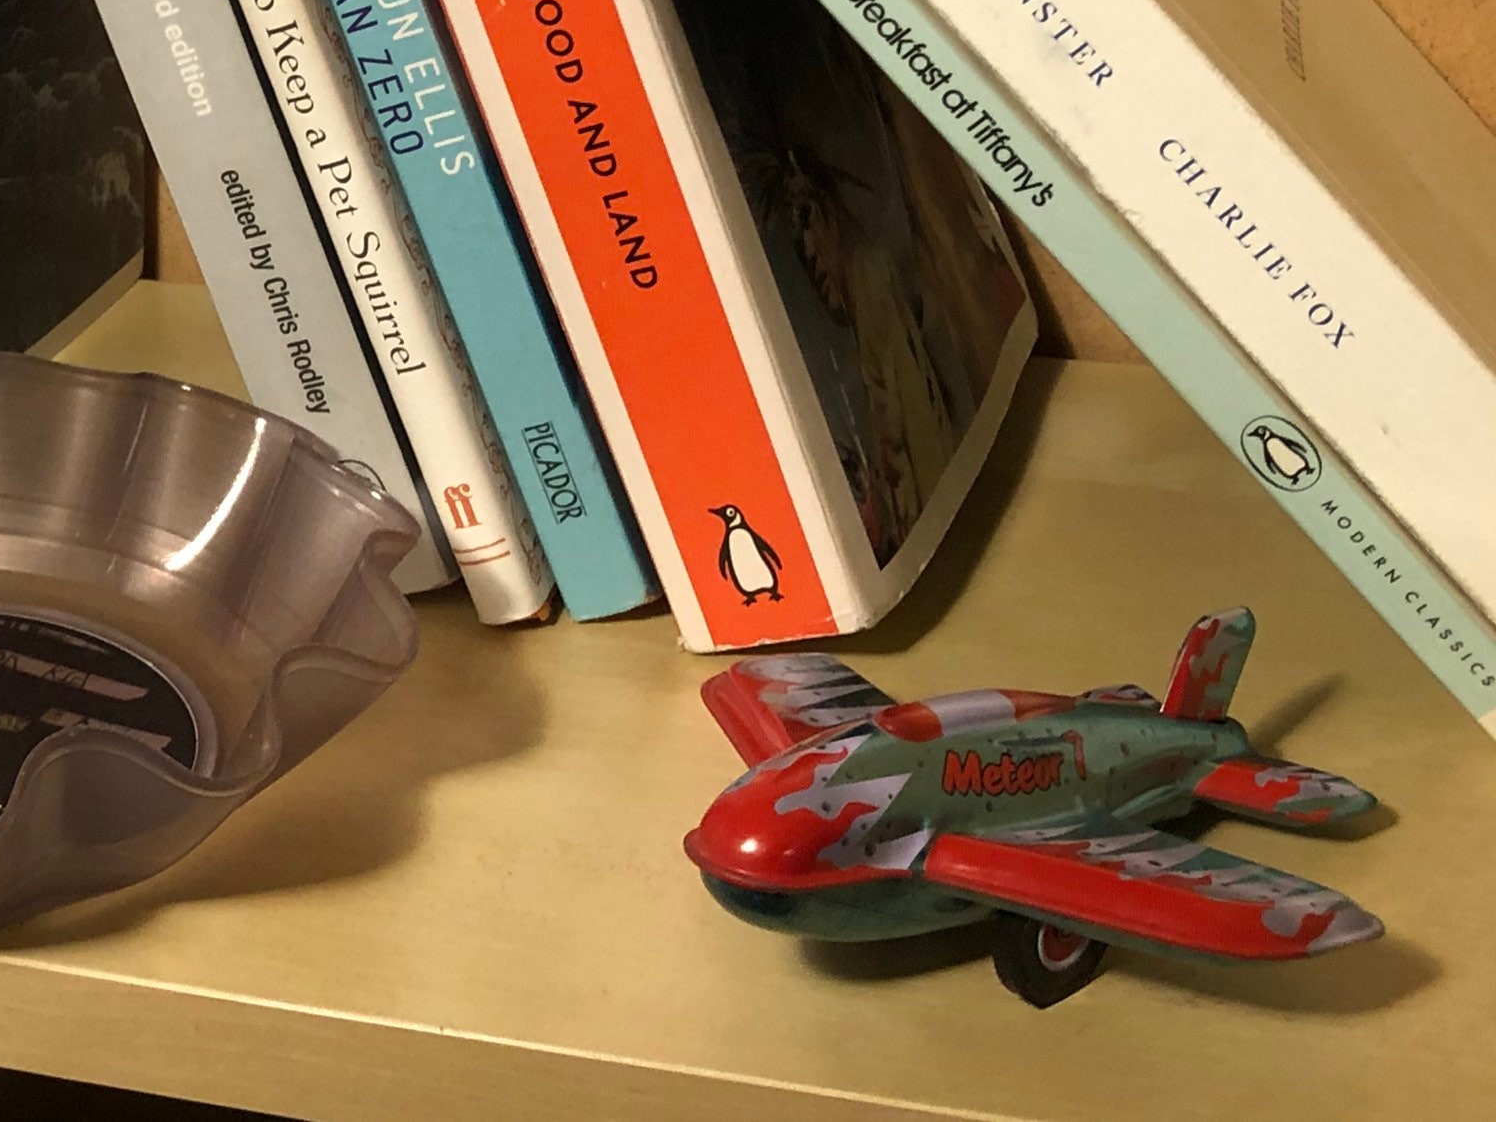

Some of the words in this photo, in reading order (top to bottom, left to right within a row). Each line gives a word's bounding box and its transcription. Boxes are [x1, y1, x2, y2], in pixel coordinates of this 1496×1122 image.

[164, 24, 213, 117] edition
[355, 48, 426, 156] ZERO
[402, 56, 476, 177] ELLIS
[940, 86, 975, 120] at
[966, 109, 1055, 209] Tiffany's
[265, 19, 315, 116] Keep
[304, 127, 327, 150] a
[317, 155, 359, 220] Pet
[345, 230, 427, 376] Squirrel
[567, 98, 619, 179] AND
[602, 190, 660, 290] LAND
[1157, 137, 1292, 283] CHARLIE
[1288, 283, 1356, 351] FOX
[220, 168, 268, 242] edited
[249, 233, 275, 272] by
[263, 275, 298, 336] Chris
[286, 337, 331, 416] Rodley
[523, 421, 585, 525] PICADOR
[1320, 498, 1403, 586] MODERN
[1404, 589, 1496, 690] CLASSICS
